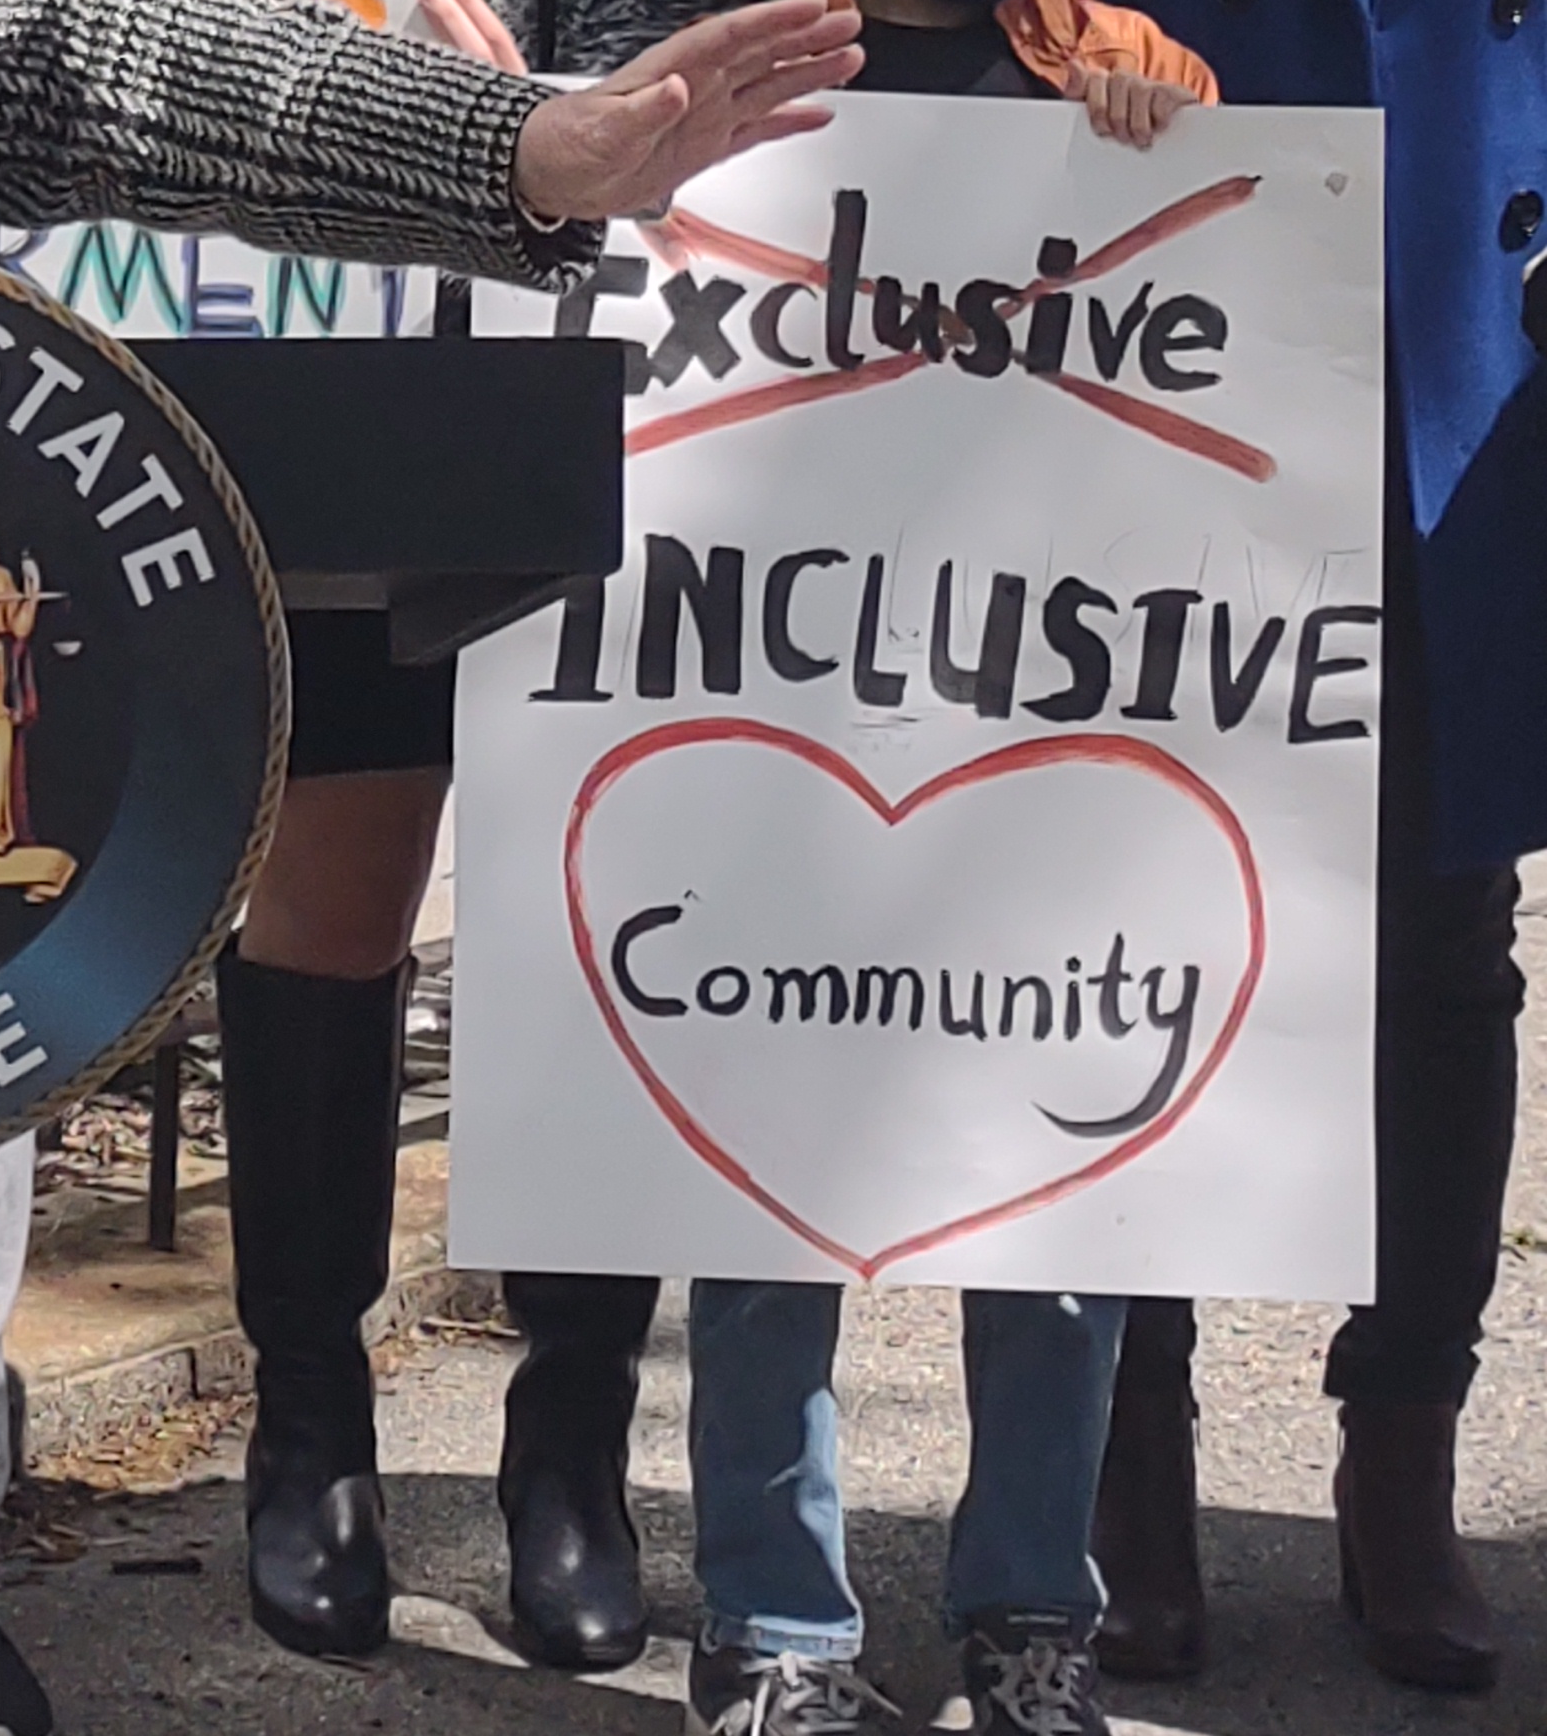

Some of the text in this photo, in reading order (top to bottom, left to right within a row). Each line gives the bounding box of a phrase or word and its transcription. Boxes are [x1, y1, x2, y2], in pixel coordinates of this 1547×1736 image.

[554, 189, 1228, 395] Exclusive
[527, 534, 1381, 744] INCLUSIVE
[610, 902, 1200, 1138] Community
